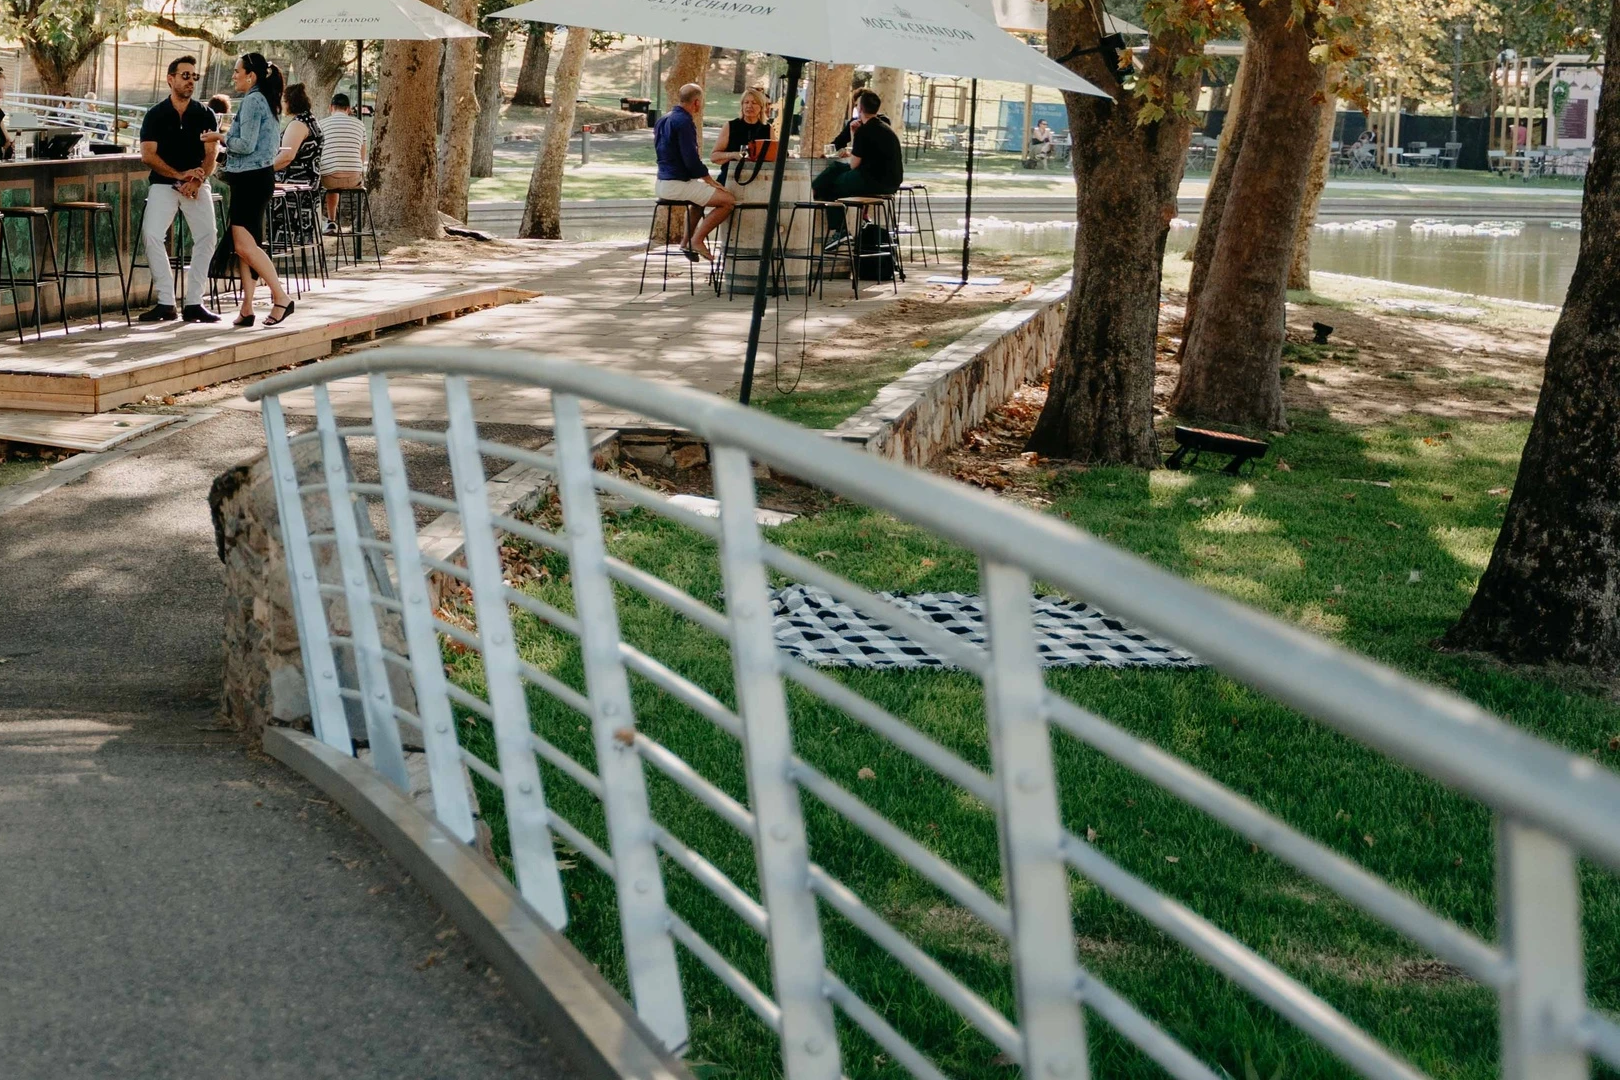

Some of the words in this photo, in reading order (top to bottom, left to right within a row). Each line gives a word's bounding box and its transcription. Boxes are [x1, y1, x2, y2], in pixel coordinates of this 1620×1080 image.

[681, 0, 692, 7] &
[694, 0, 776, 16] CHANDON
[334, 16, 381, 24] CHANDON
[907, 22, 976, 41] CHANDON
